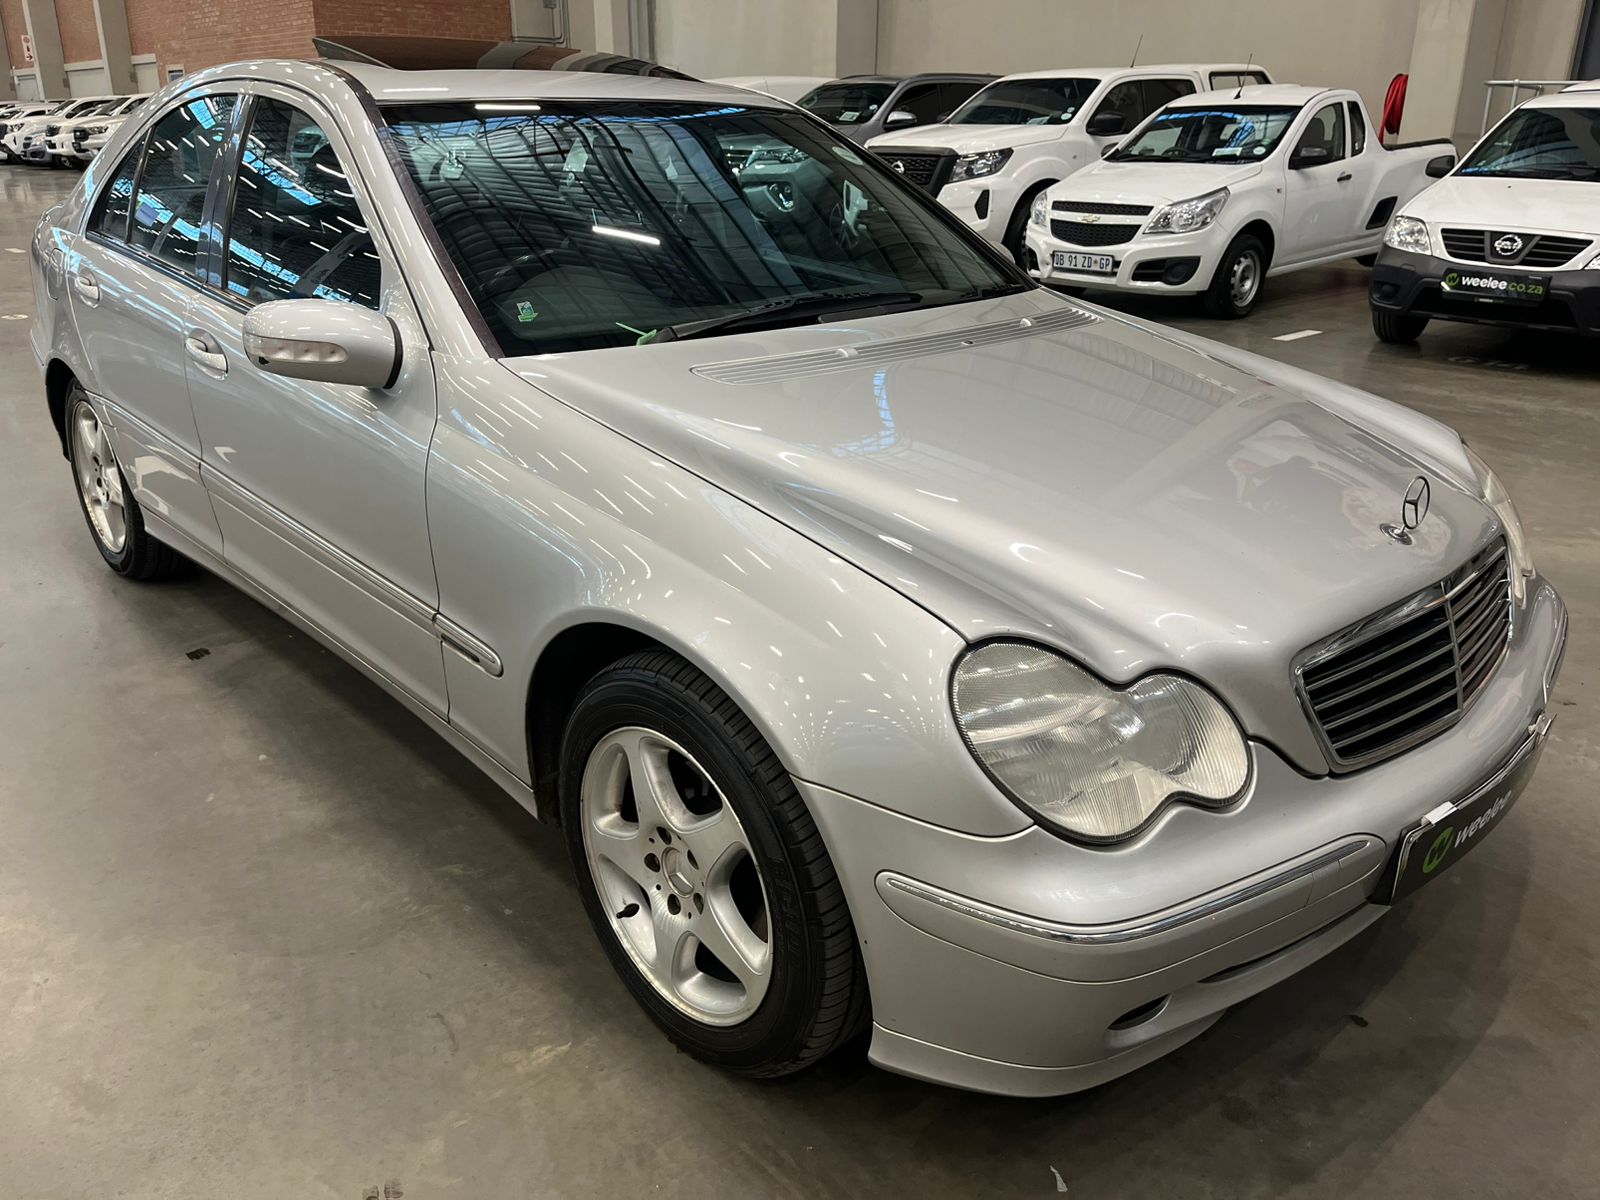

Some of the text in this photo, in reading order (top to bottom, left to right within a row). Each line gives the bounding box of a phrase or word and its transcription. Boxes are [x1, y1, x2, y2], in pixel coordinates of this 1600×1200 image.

[1068, 255, 1078, 267] 91
[1081, 256, 1093, 268] ZD
[1099, 257, 1111, 270] GP
